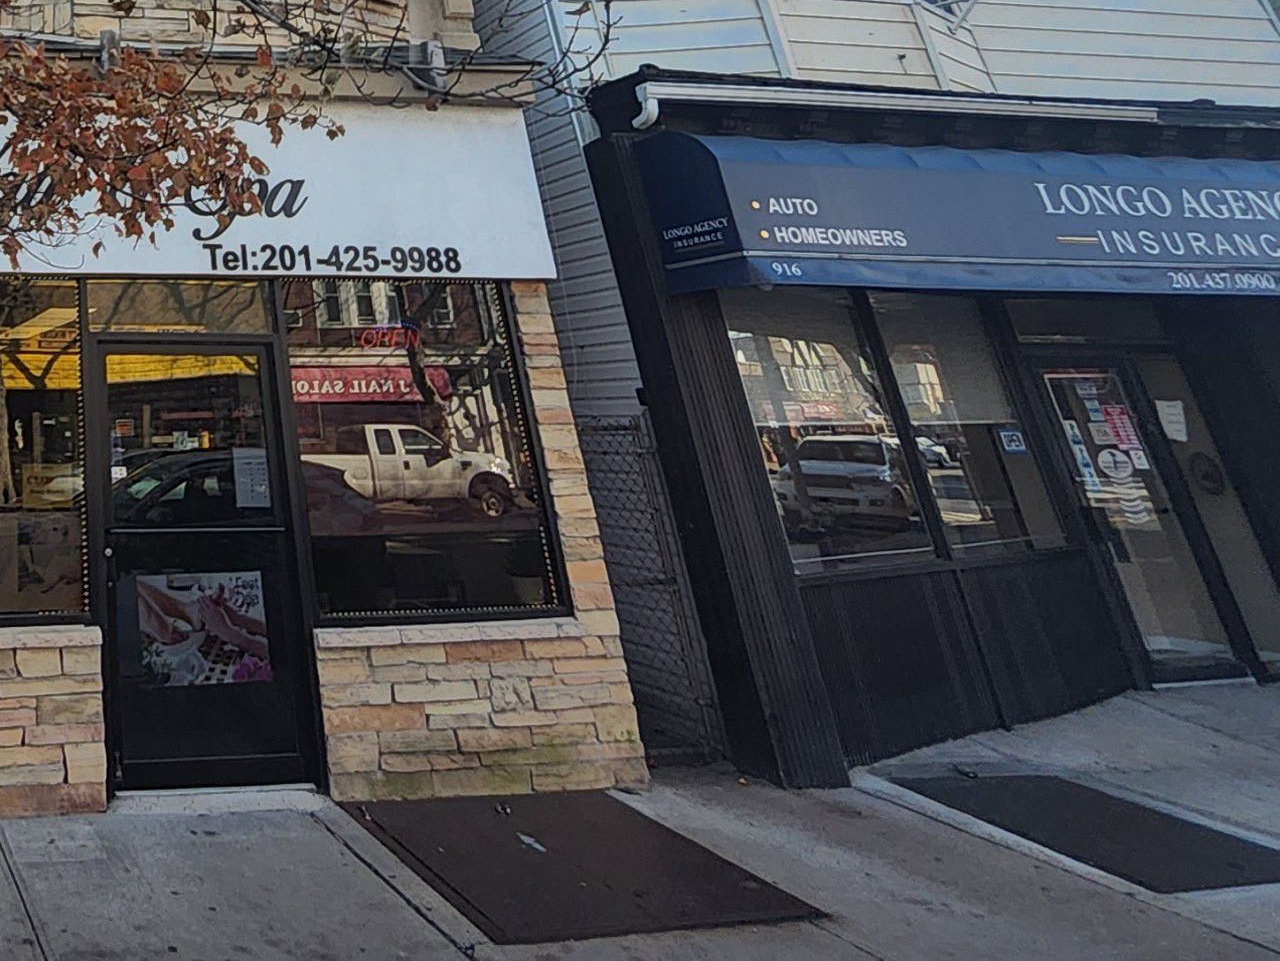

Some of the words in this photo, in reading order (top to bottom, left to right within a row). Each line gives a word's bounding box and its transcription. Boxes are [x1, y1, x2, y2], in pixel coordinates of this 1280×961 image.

[769, 197, 818, 216] AUTO
[1033, 182, 1172, 218] LONGO
[1181, 187, 1280, 220] AGEN
[662, 224, 692, 239] LONGO
[693, 217, 728, 234] AGENCY
[773, 225, 907, 248] HOMEOWNERS
[672, 231, 724, 248] INSURANCE
[202, 243, 462, 274] Tel:201-425-9988
[772, 261, 802, 278] 916
[1167, 271, 1276, 289] 201.437.0900
